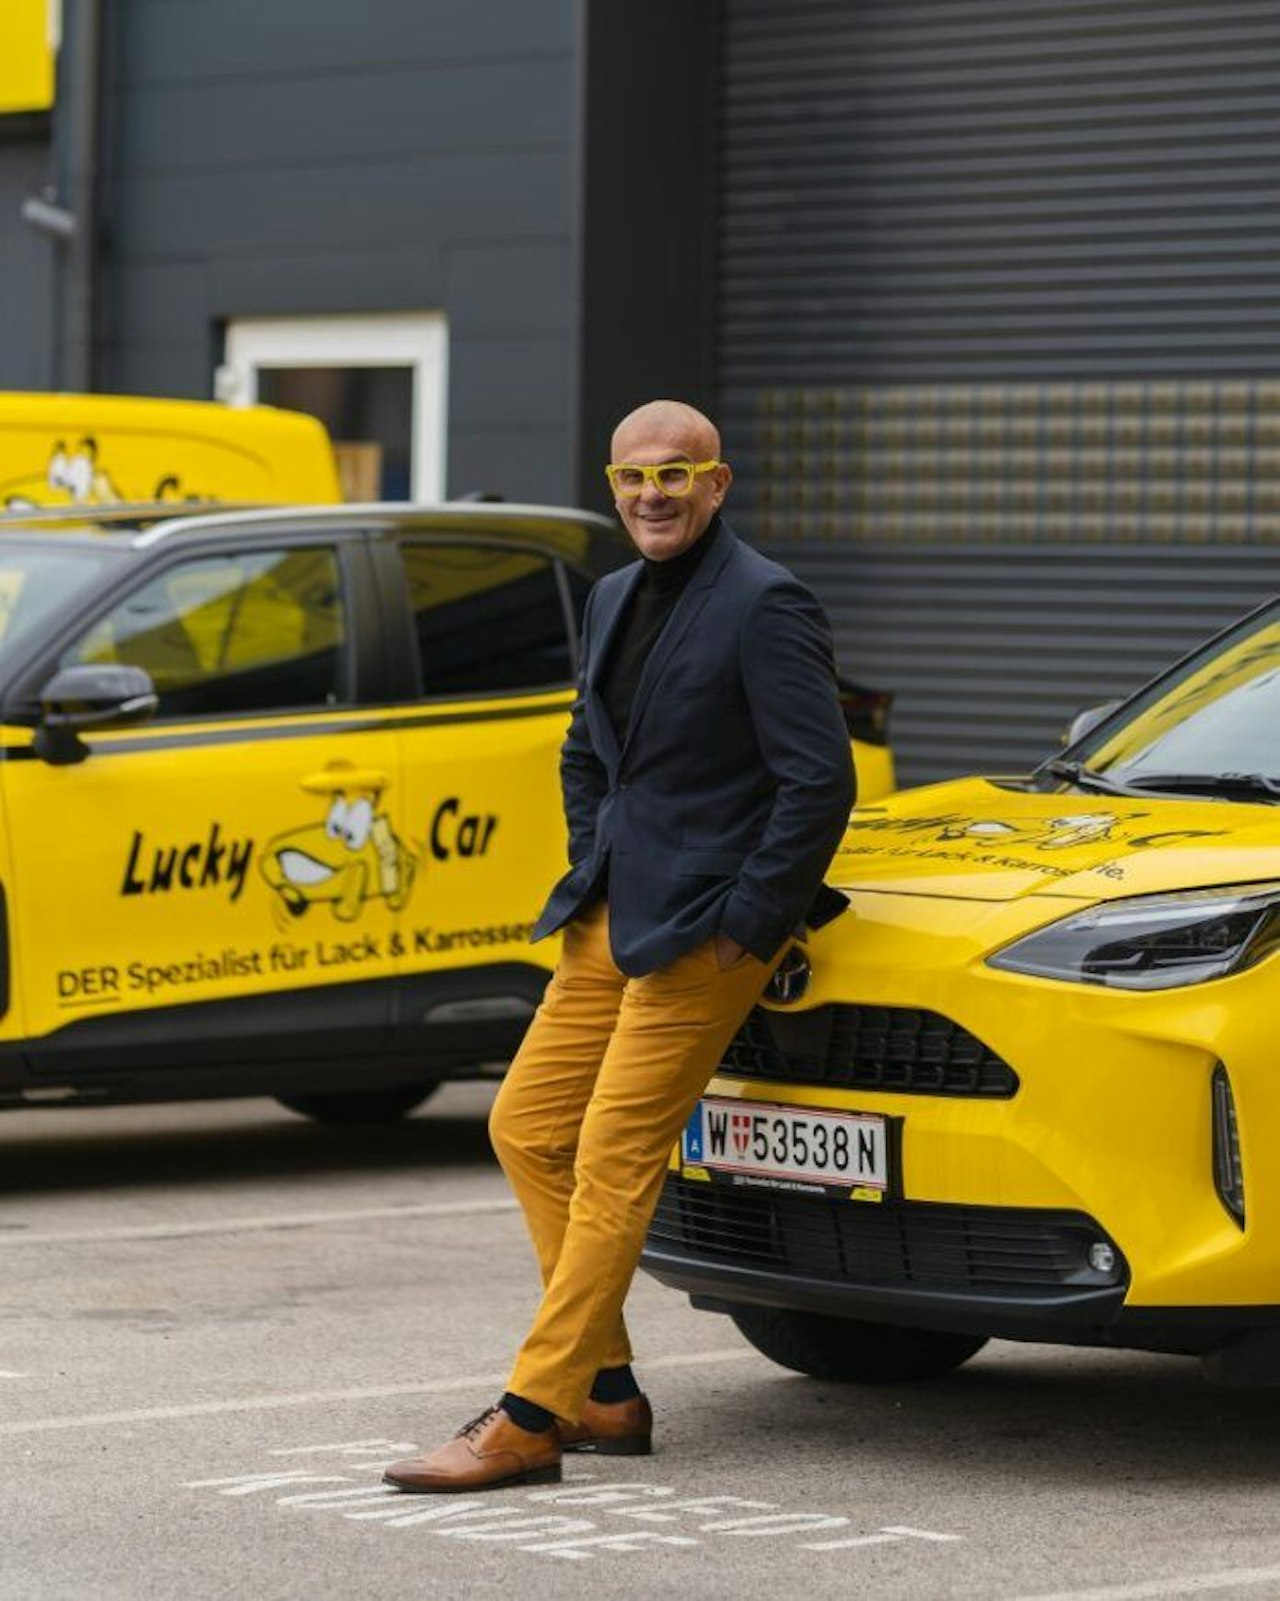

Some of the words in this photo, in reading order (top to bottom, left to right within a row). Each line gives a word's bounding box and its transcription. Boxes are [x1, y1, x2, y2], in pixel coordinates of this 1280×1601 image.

[121, 823, 253, 901] Lucky
[430, 797, 499, 861] Car
[57, 965, 120, 997] DER
[127, 948, 262, 993] Spezialist
[269, 943, 309, 973] für
[316, 931, 380, 966] Lack
[391, 928, 406, 958] &
